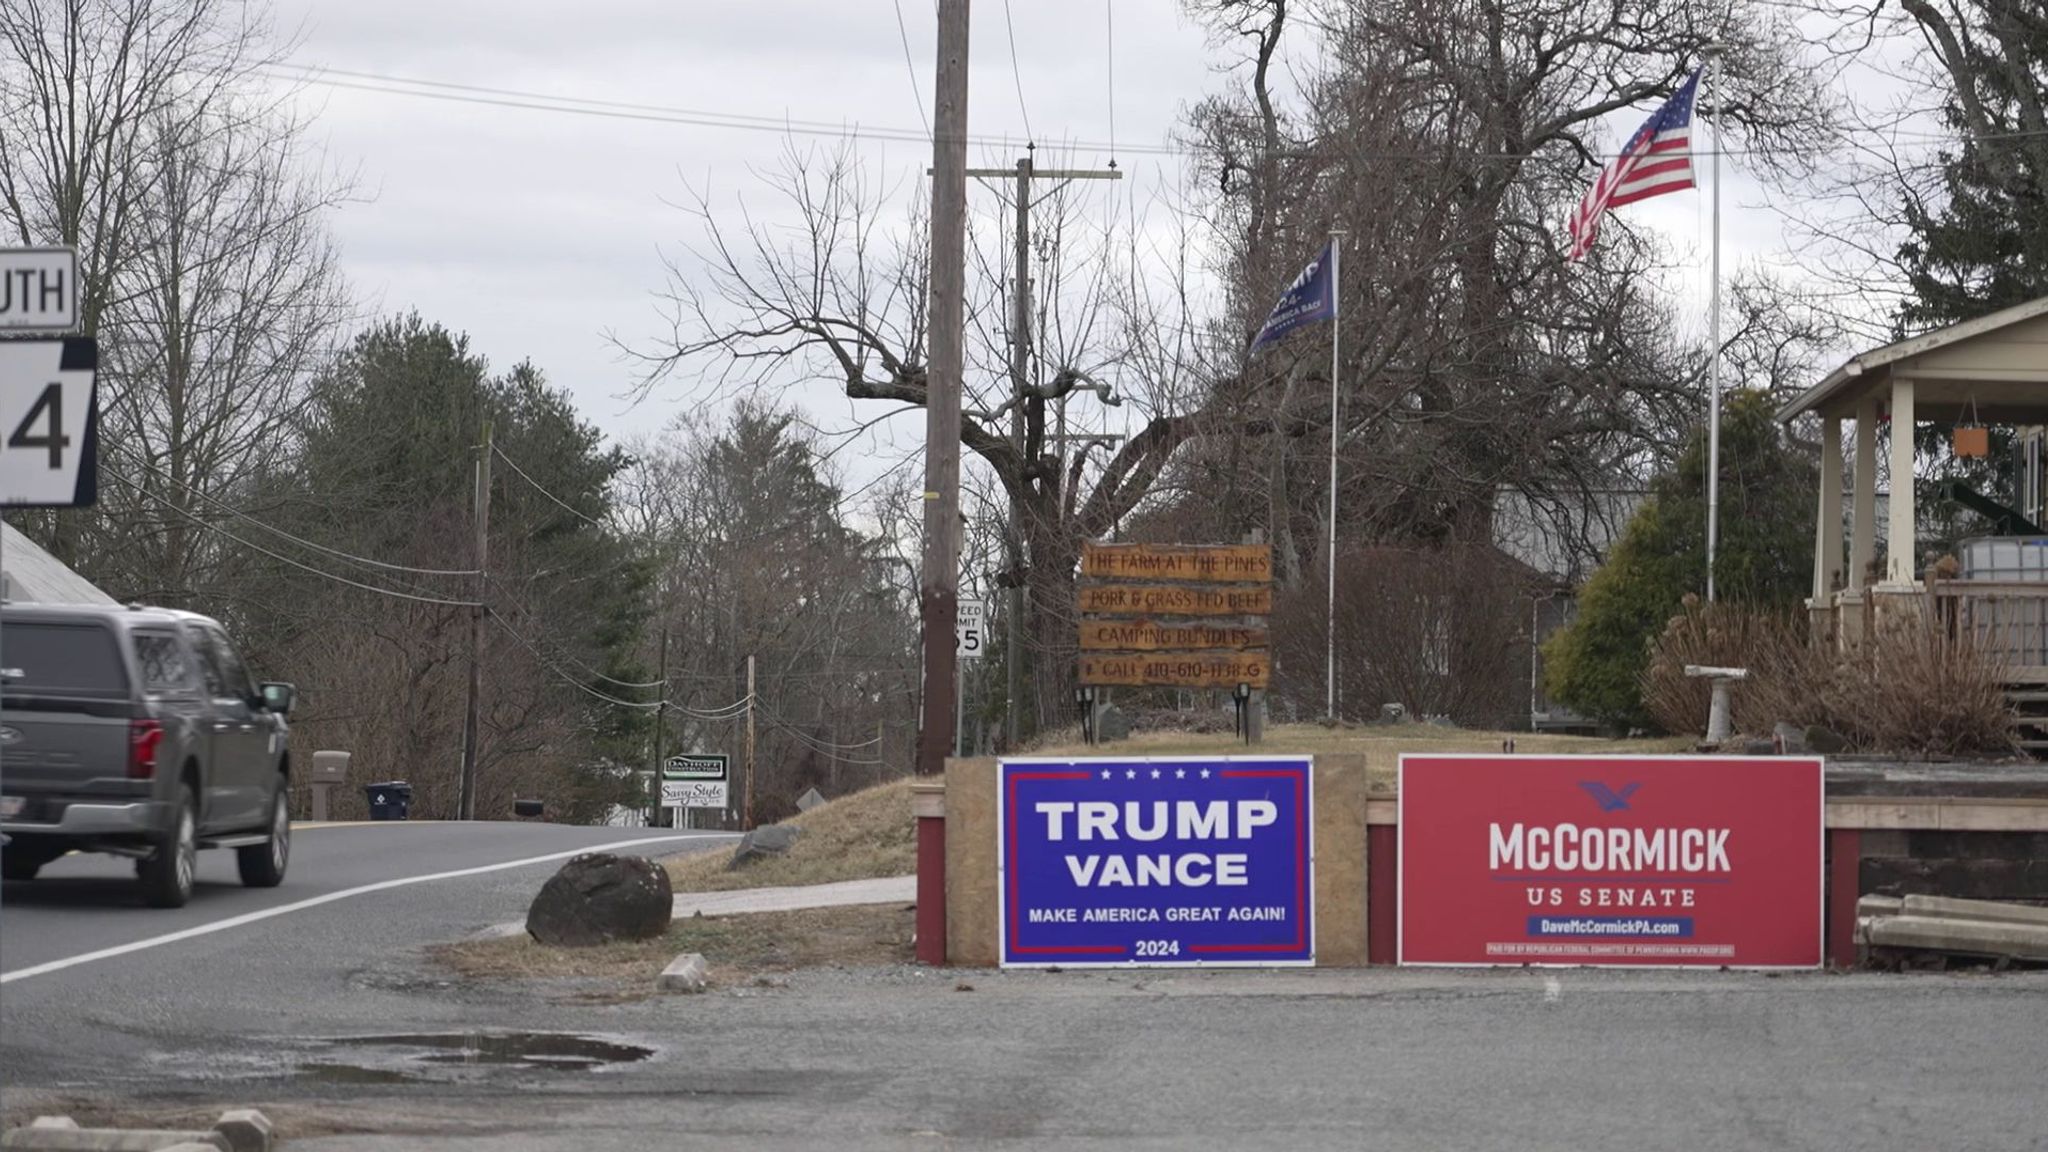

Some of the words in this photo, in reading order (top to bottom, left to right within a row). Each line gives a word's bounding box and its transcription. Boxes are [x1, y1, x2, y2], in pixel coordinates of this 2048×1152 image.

[0, 269, 63, 313] UTH
[0, 382, 70, 470] 4
[1121, 555, 1161, 569] FARM
[1166, 555, 1184, 570] AT
[1224, 556, 1267, 573] PINES
[1091, 591, 1127, 606] PORK
[1145, 592, 1191, 608] GRASS
[957, 606, 982, 616] EED
[958, 618, 977, 627] MIT
[956, 629, 979, 651] 5
[1097, 628, 1171, 645] CAMPING
[1176, 629, 1250, 646] BUNDLES
[1035, 800, 1278, 841] TRUMP
[1065, 853, 1248, 887] VANCE
[1527, 888, 1563, 906] US
[1579, 888, 1695, 907] SENATE
[1029, 908, 1077, 923] MAKE
[1083, 908, 1160, 922] AMERICA
[1166, 907, 1221, 921] GREAT
[1227, 907, 1286, 921] AGAIN!
[1541, 919, 1679, 935] DaveMcCormickPA.com
[1135, 940, 1180, 956] 2024
